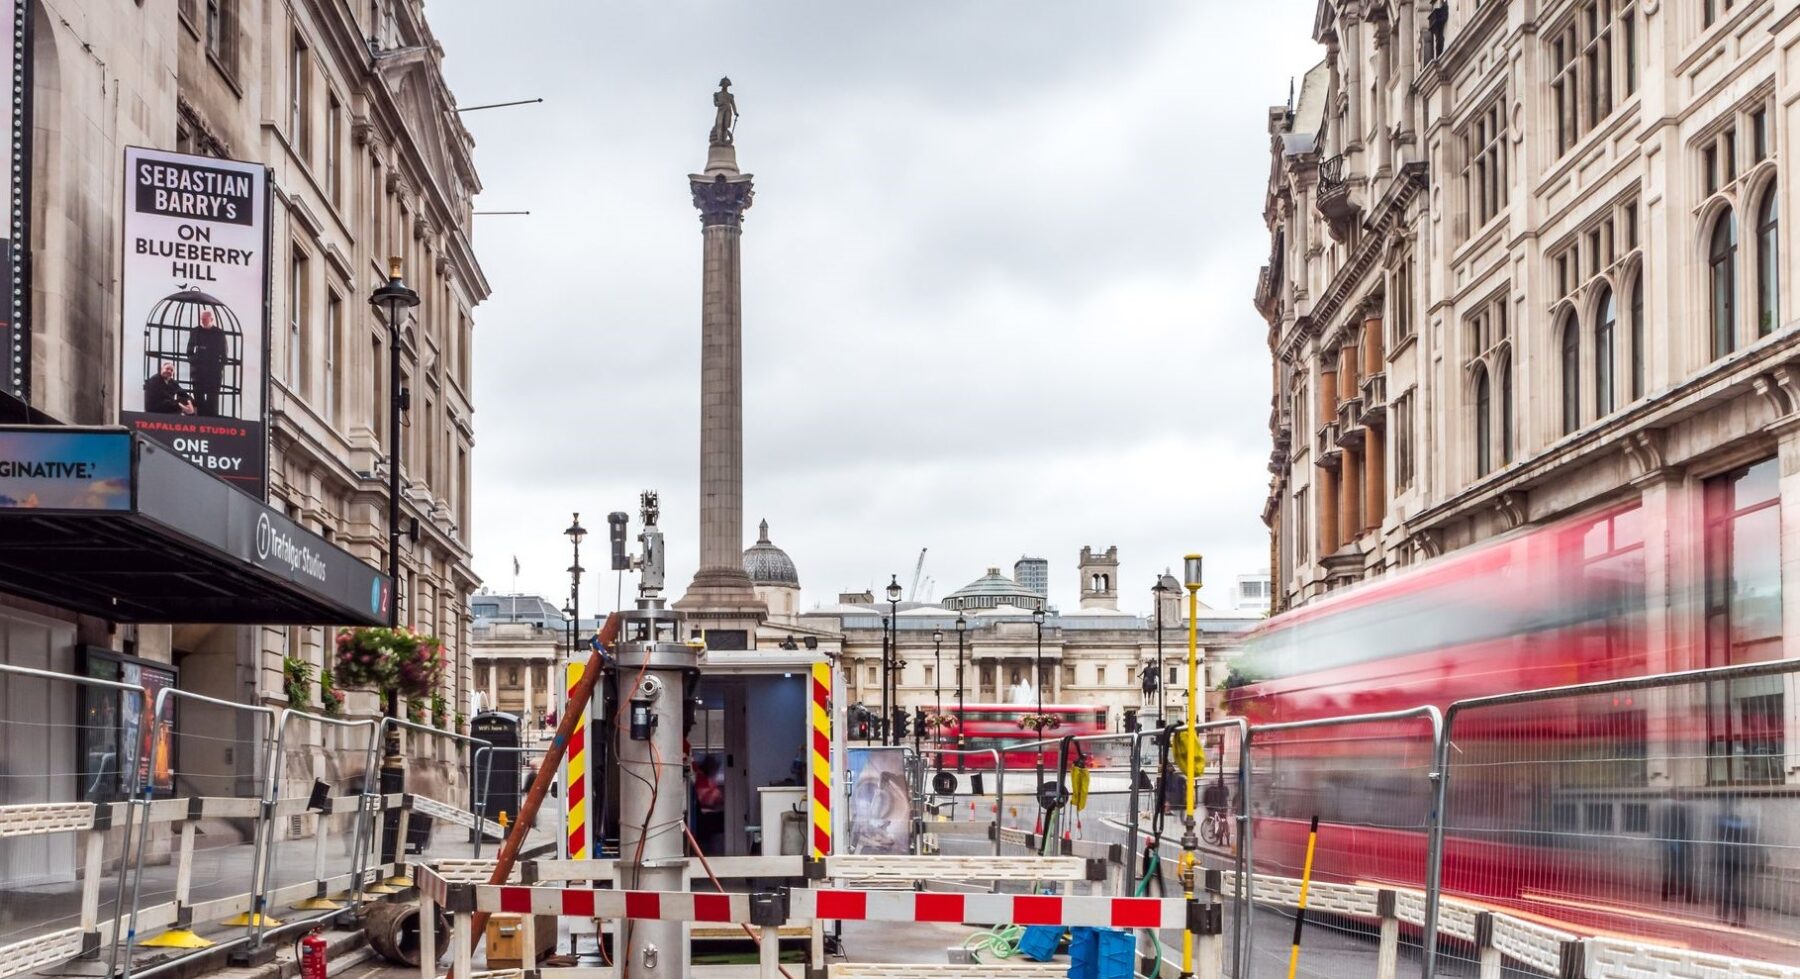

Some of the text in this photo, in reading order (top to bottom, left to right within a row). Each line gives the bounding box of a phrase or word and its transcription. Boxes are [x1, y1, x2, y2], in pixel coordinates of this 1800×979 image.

[140, 164, 249, 198] SEBASTIAN
[177, 224, 210, 243] ON
[136, 237, 253, 266] BLUEBERRY
[172, 261, 217, 281] HILL
[135, 421, 196, 433] TRAFALGAR
[200, 425, 237, 436] STUDIO
[173, 438, 208, 453] ONE
[207, 455, 242, 471] BOY
[271, 527, 302, 572] Trafalgar
[302, 546, 326, 581] Studios
[381, 587, 388, 612] 2
